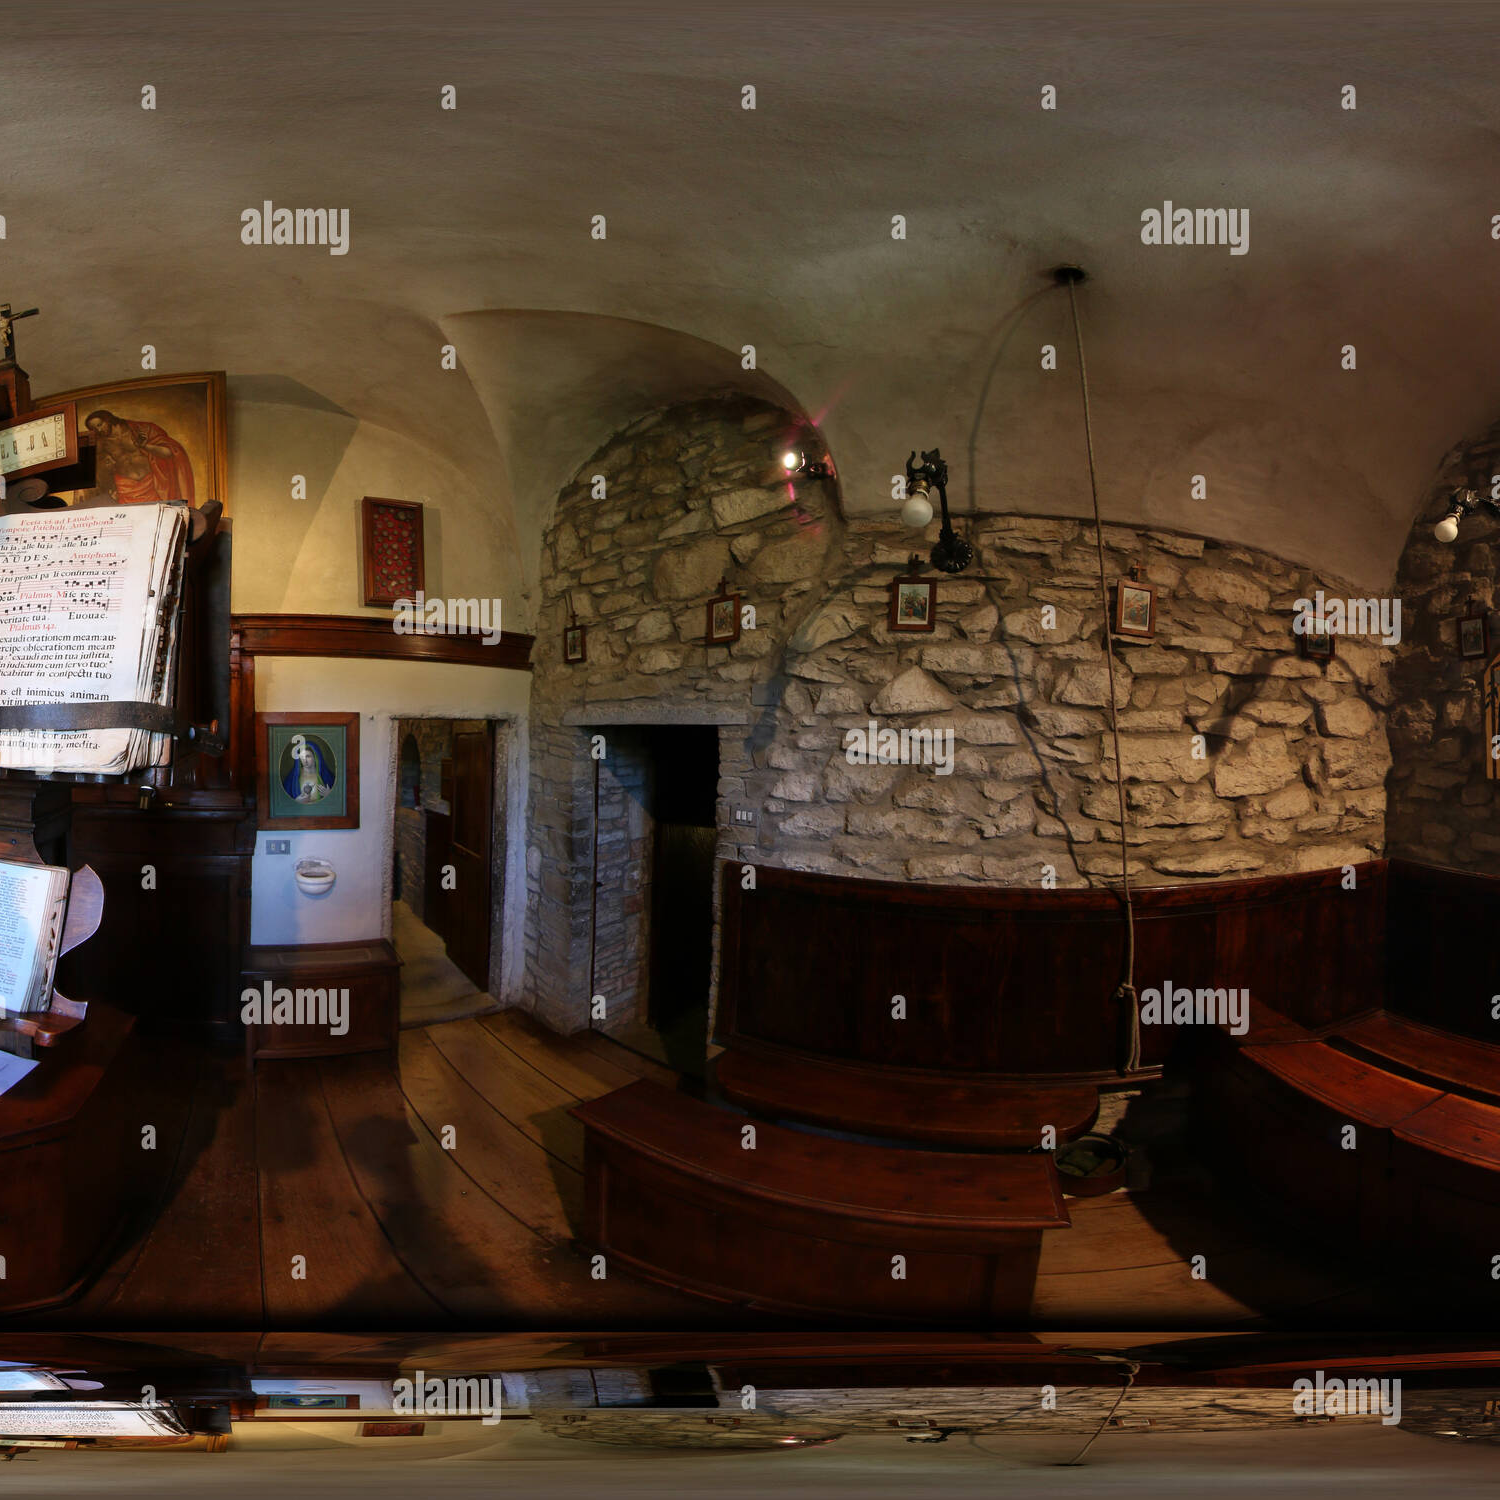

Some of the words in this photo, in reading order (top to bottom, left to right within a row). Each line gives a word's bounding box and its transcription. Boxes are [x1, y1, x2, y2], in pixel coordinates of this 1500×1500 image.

[95, 671, 112, 680] tuo
[26, 687, 65, 697] inimicus
[70, 690, 109, 701] animam
